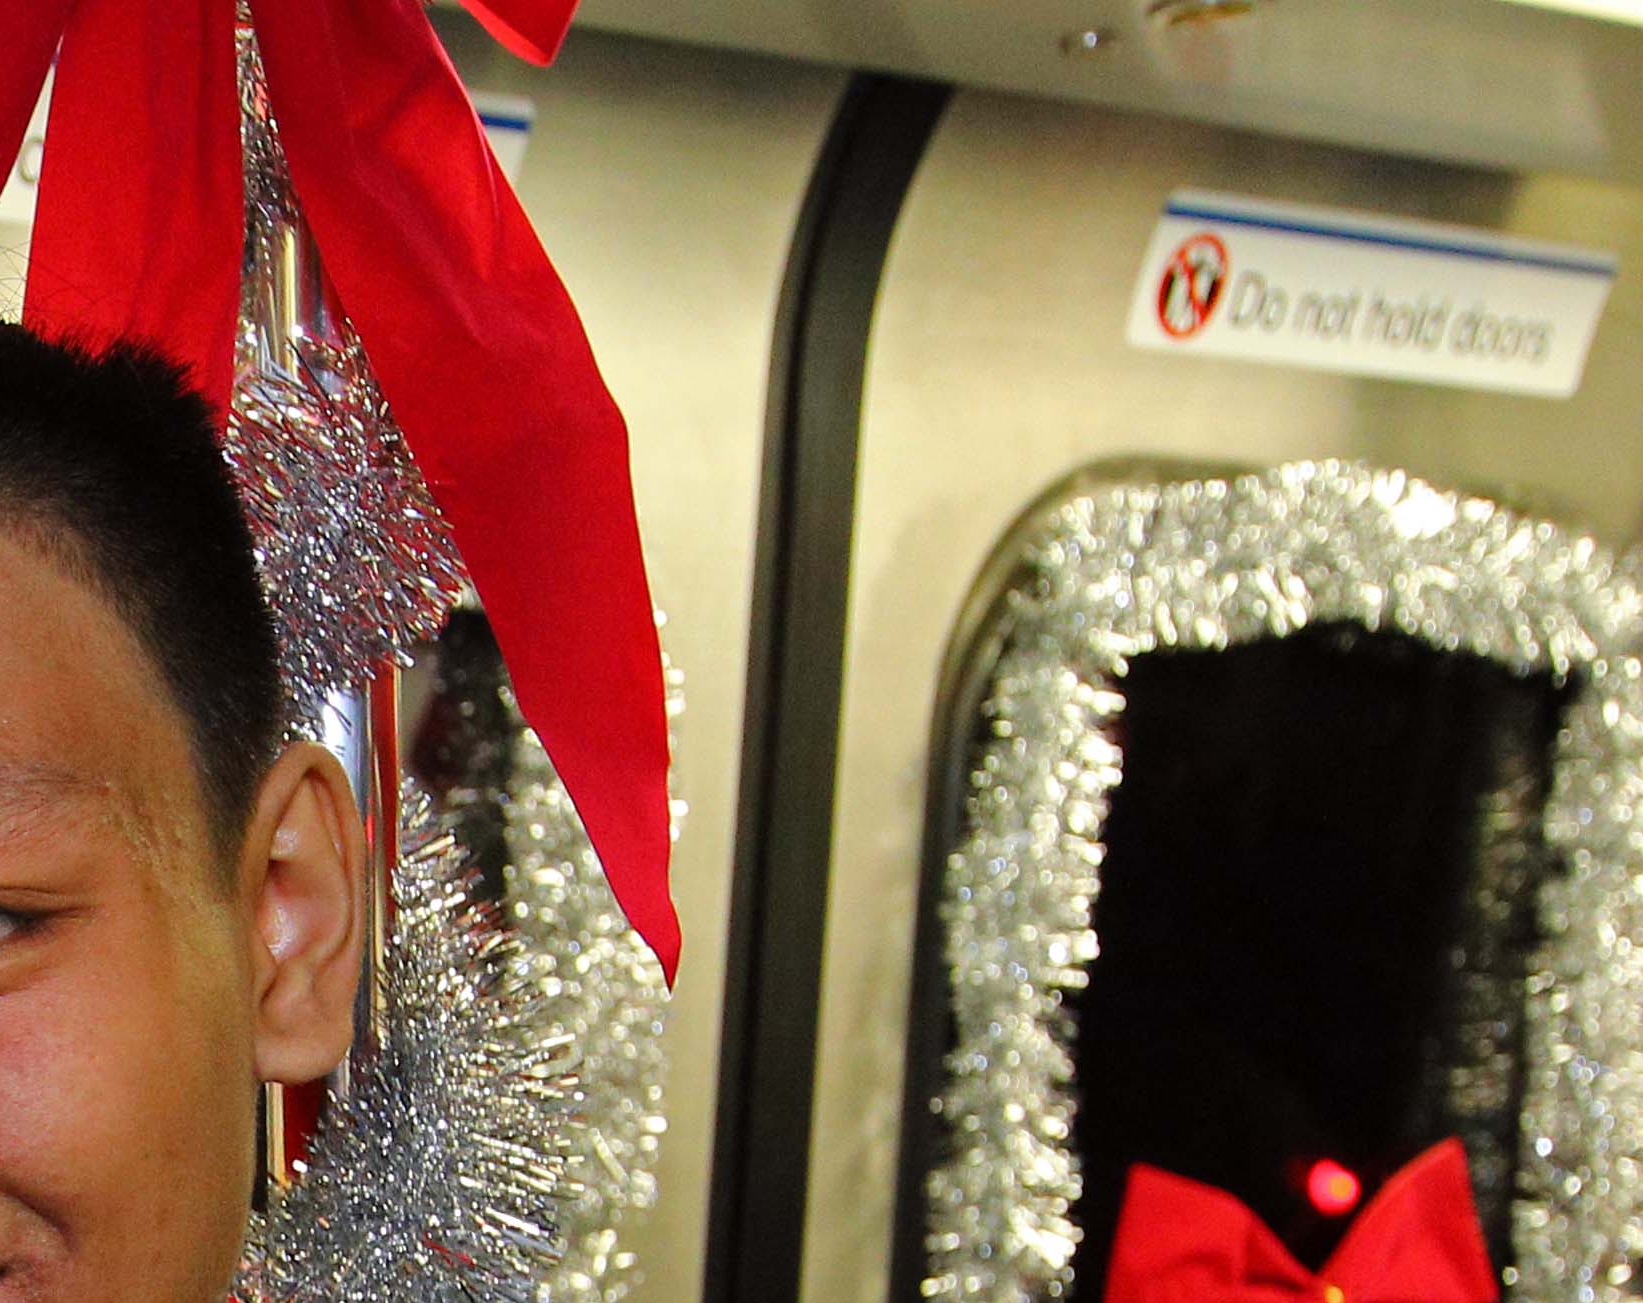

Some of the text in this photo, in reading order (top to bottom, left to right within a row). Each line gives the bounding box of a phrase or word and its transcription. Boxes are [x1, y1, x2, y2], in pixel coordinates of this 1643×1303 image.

[1227, 268, 1556, 366] Do not hold doors
